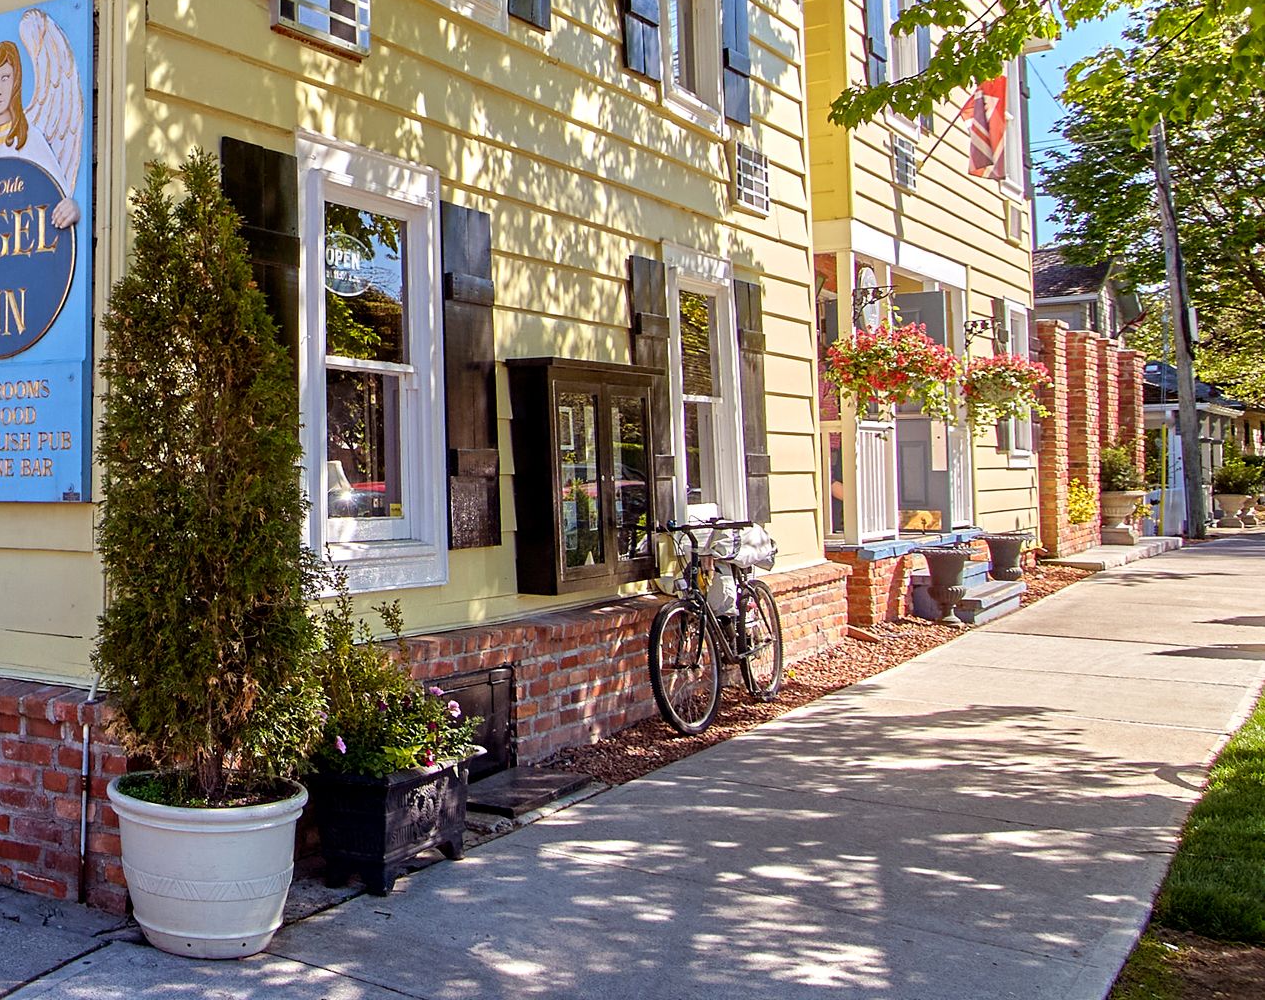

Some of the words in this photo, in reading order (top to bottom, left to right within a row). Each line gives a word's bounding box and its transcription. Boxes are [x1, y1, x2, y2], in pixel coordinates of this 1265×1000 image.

[326, 246, 361, 270] OPEN
[38, 431, 72, 451] PUB
[20, 457, 54, 477] BAR
